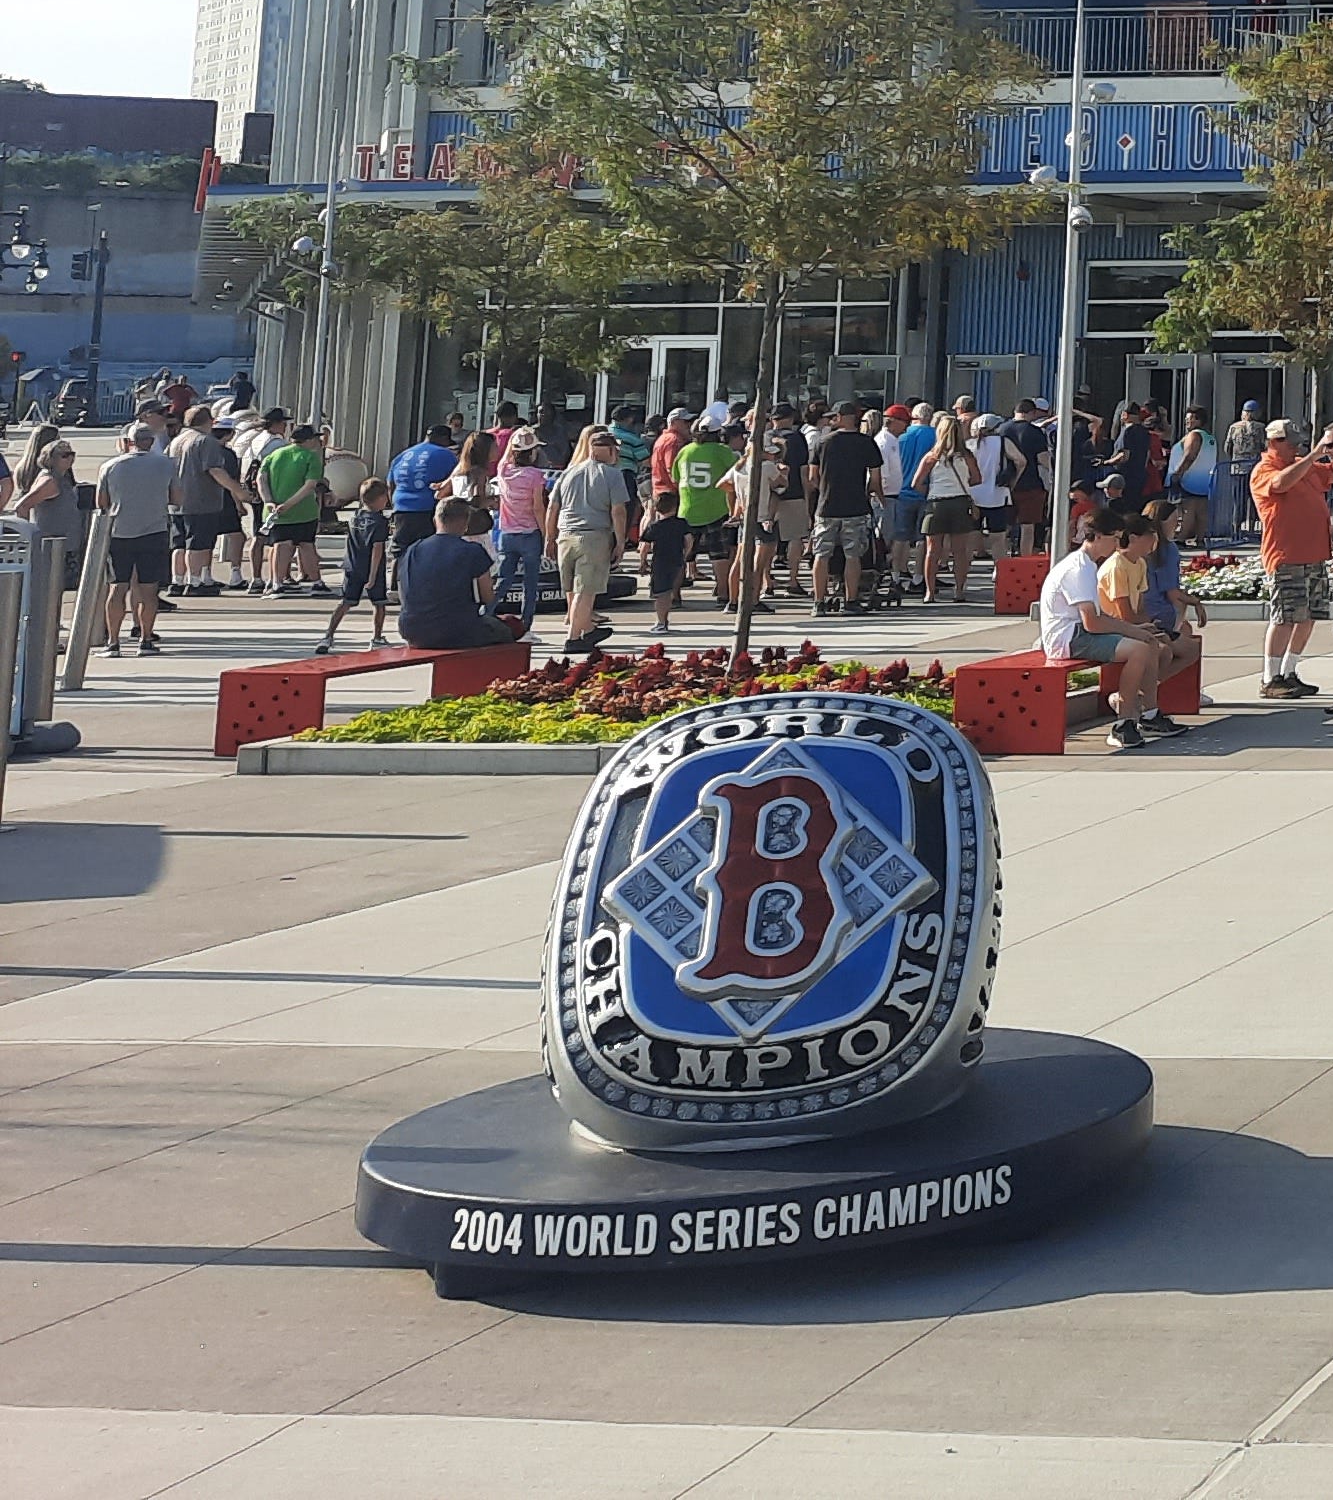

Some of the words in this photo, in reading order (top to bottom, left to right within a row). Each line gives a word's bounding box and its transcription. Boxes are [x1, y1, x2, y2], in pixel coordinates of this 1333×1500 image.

[1150, 103, 1290, 171] HOM
[613, 712, 944, 794] WORLD
[675, 766, 858, 1000] B
[581, 911, 944, 1089] CHAMPIONS
[449, 1207, 524, 1255] 2004
[533, 1212, 659, 1257] WORLD
[669, 1202, 801, 1254] SERIES
[812, 1164, 1013, 1240] CHAMPIONS
